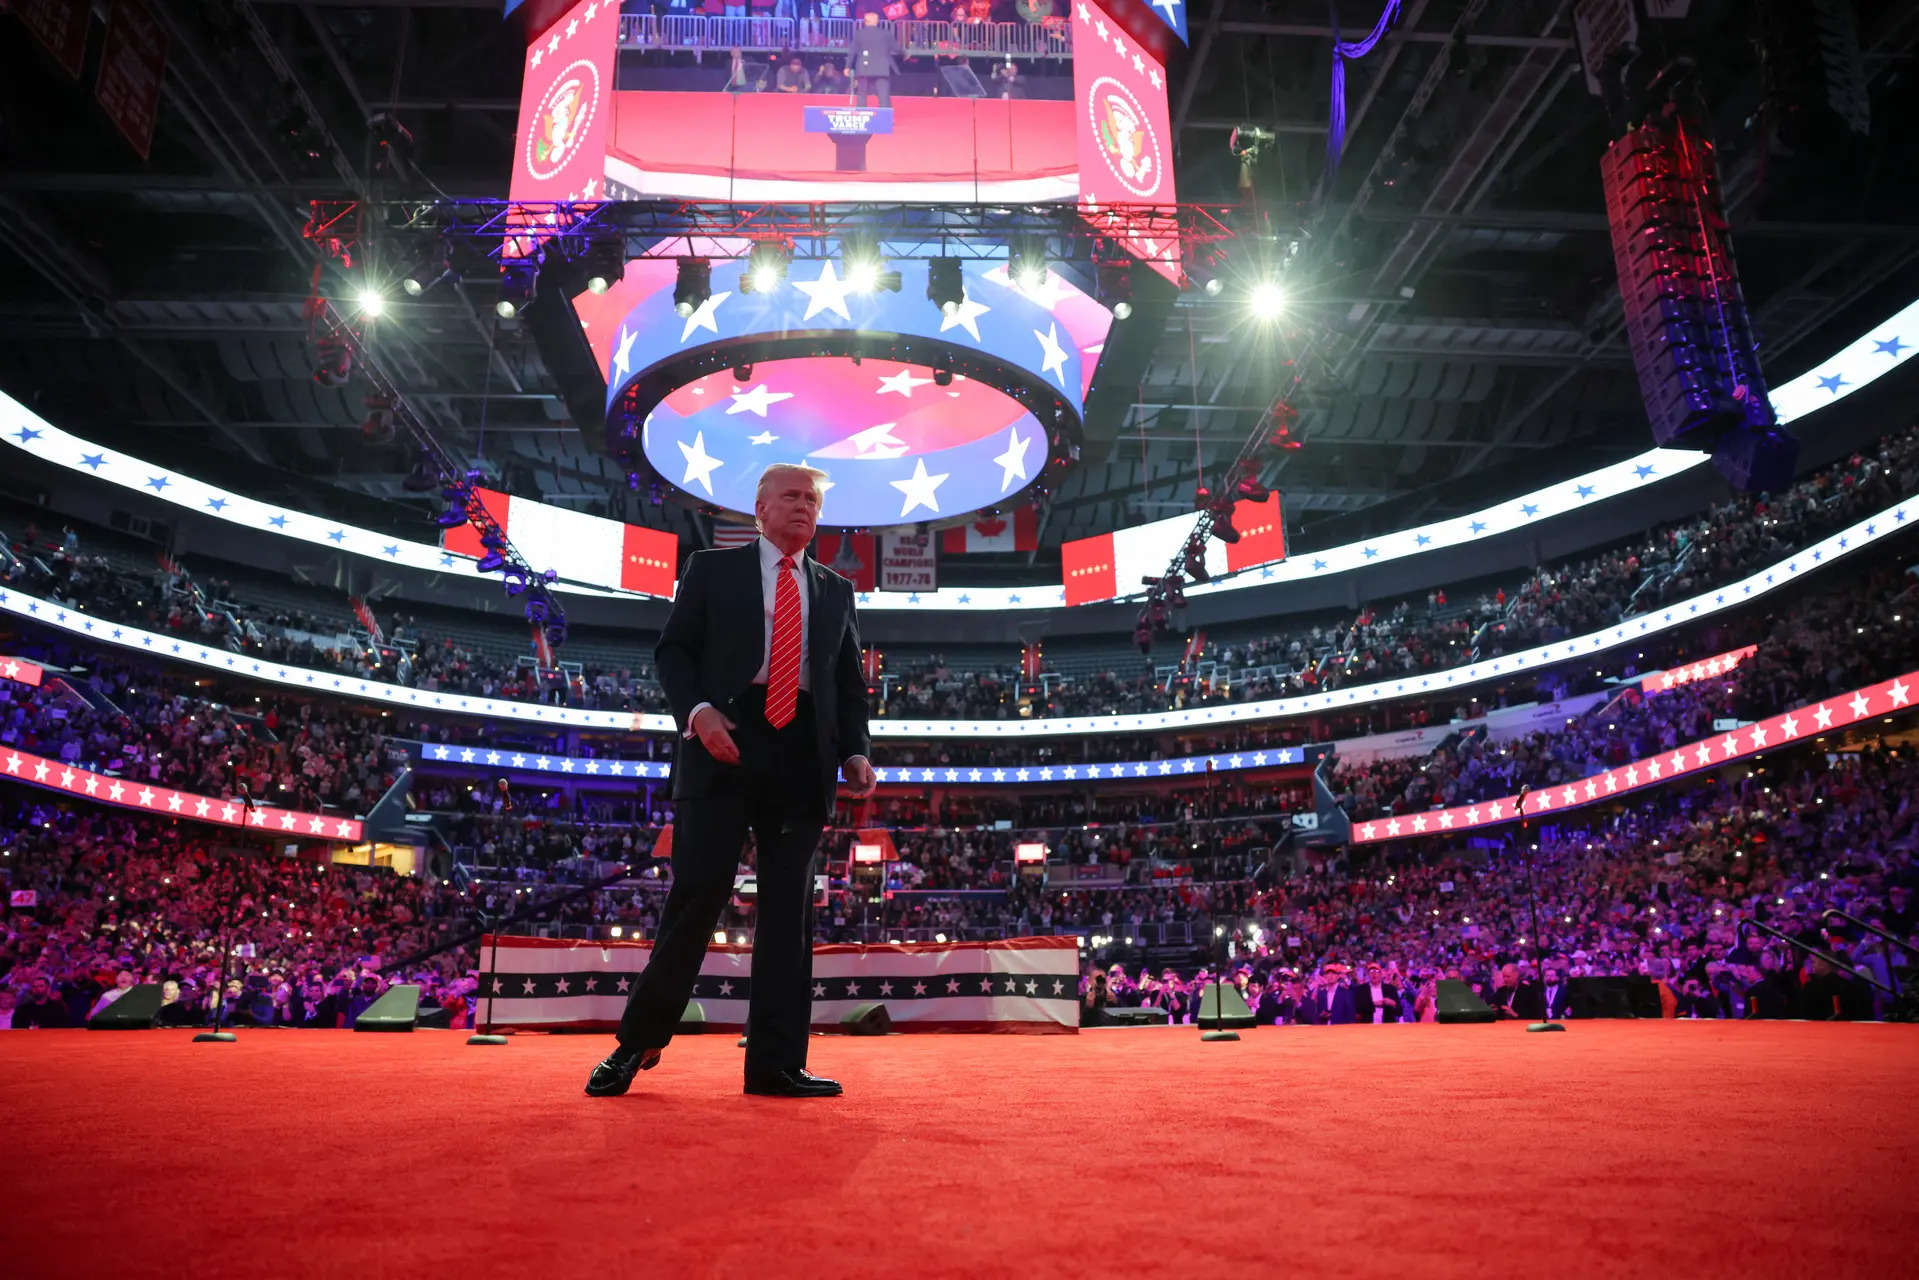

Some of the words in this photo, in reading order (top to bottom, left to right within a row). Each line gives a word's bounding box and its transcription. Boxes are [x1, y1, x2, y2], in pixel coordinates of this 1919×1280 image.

[827, 114, 870, 122] TRUMP
[832, 120, 866, 129] VANCE
[893, 547, 924, 556] WORLD
[883, 558, 934, 568] CHAMPIONS
[886, 572, 931, 585] 1977-78
